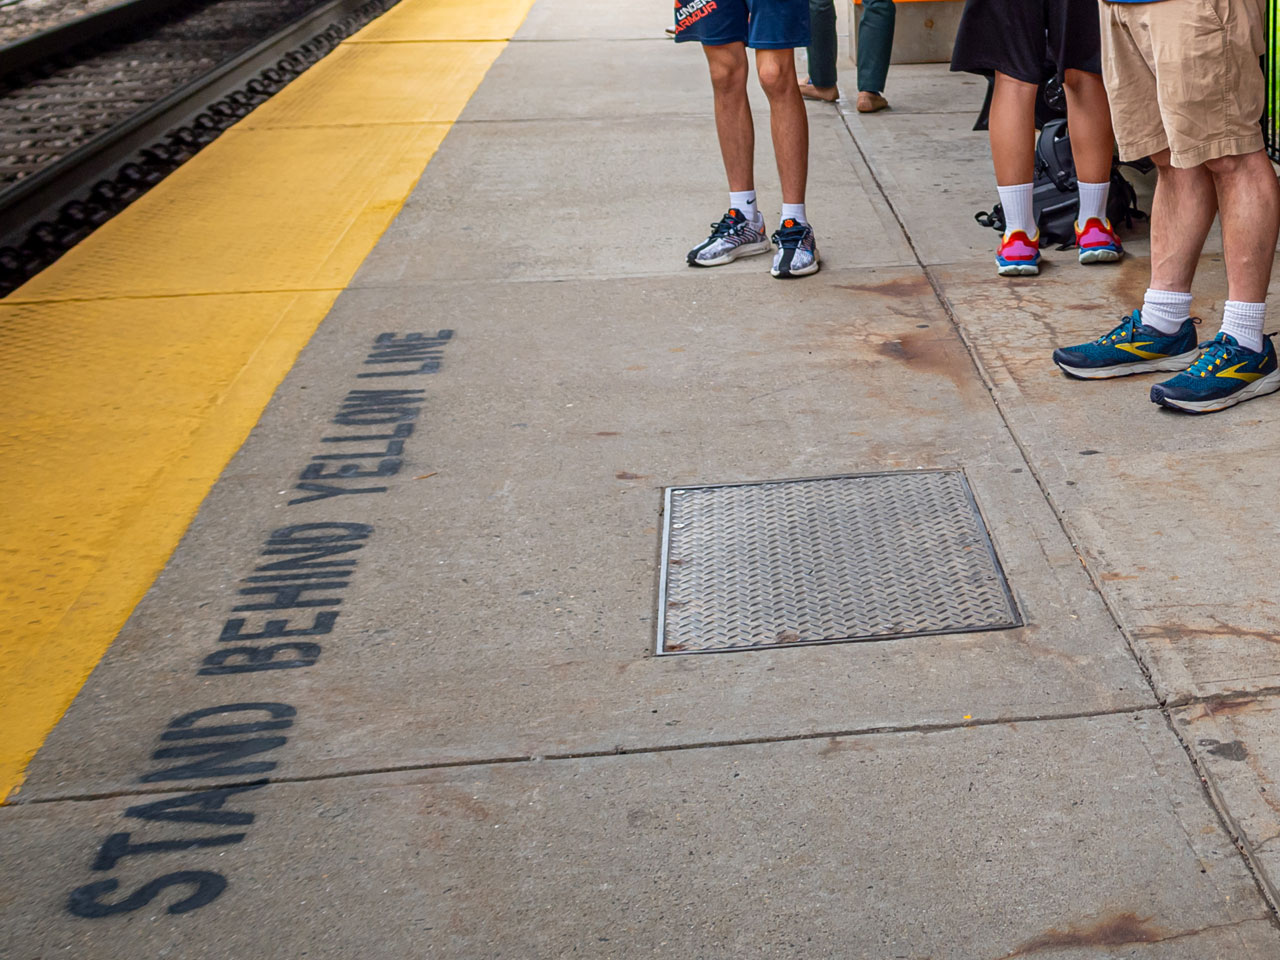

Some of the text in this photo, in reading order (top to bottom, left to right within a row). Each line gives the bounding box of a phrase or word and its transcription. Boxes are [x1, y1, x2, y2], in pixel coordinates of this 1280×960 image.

[675, 0, 718, 35] ARMOUR
[66, 328, 454, 919] STAND BEHIND YELLOW LINE
